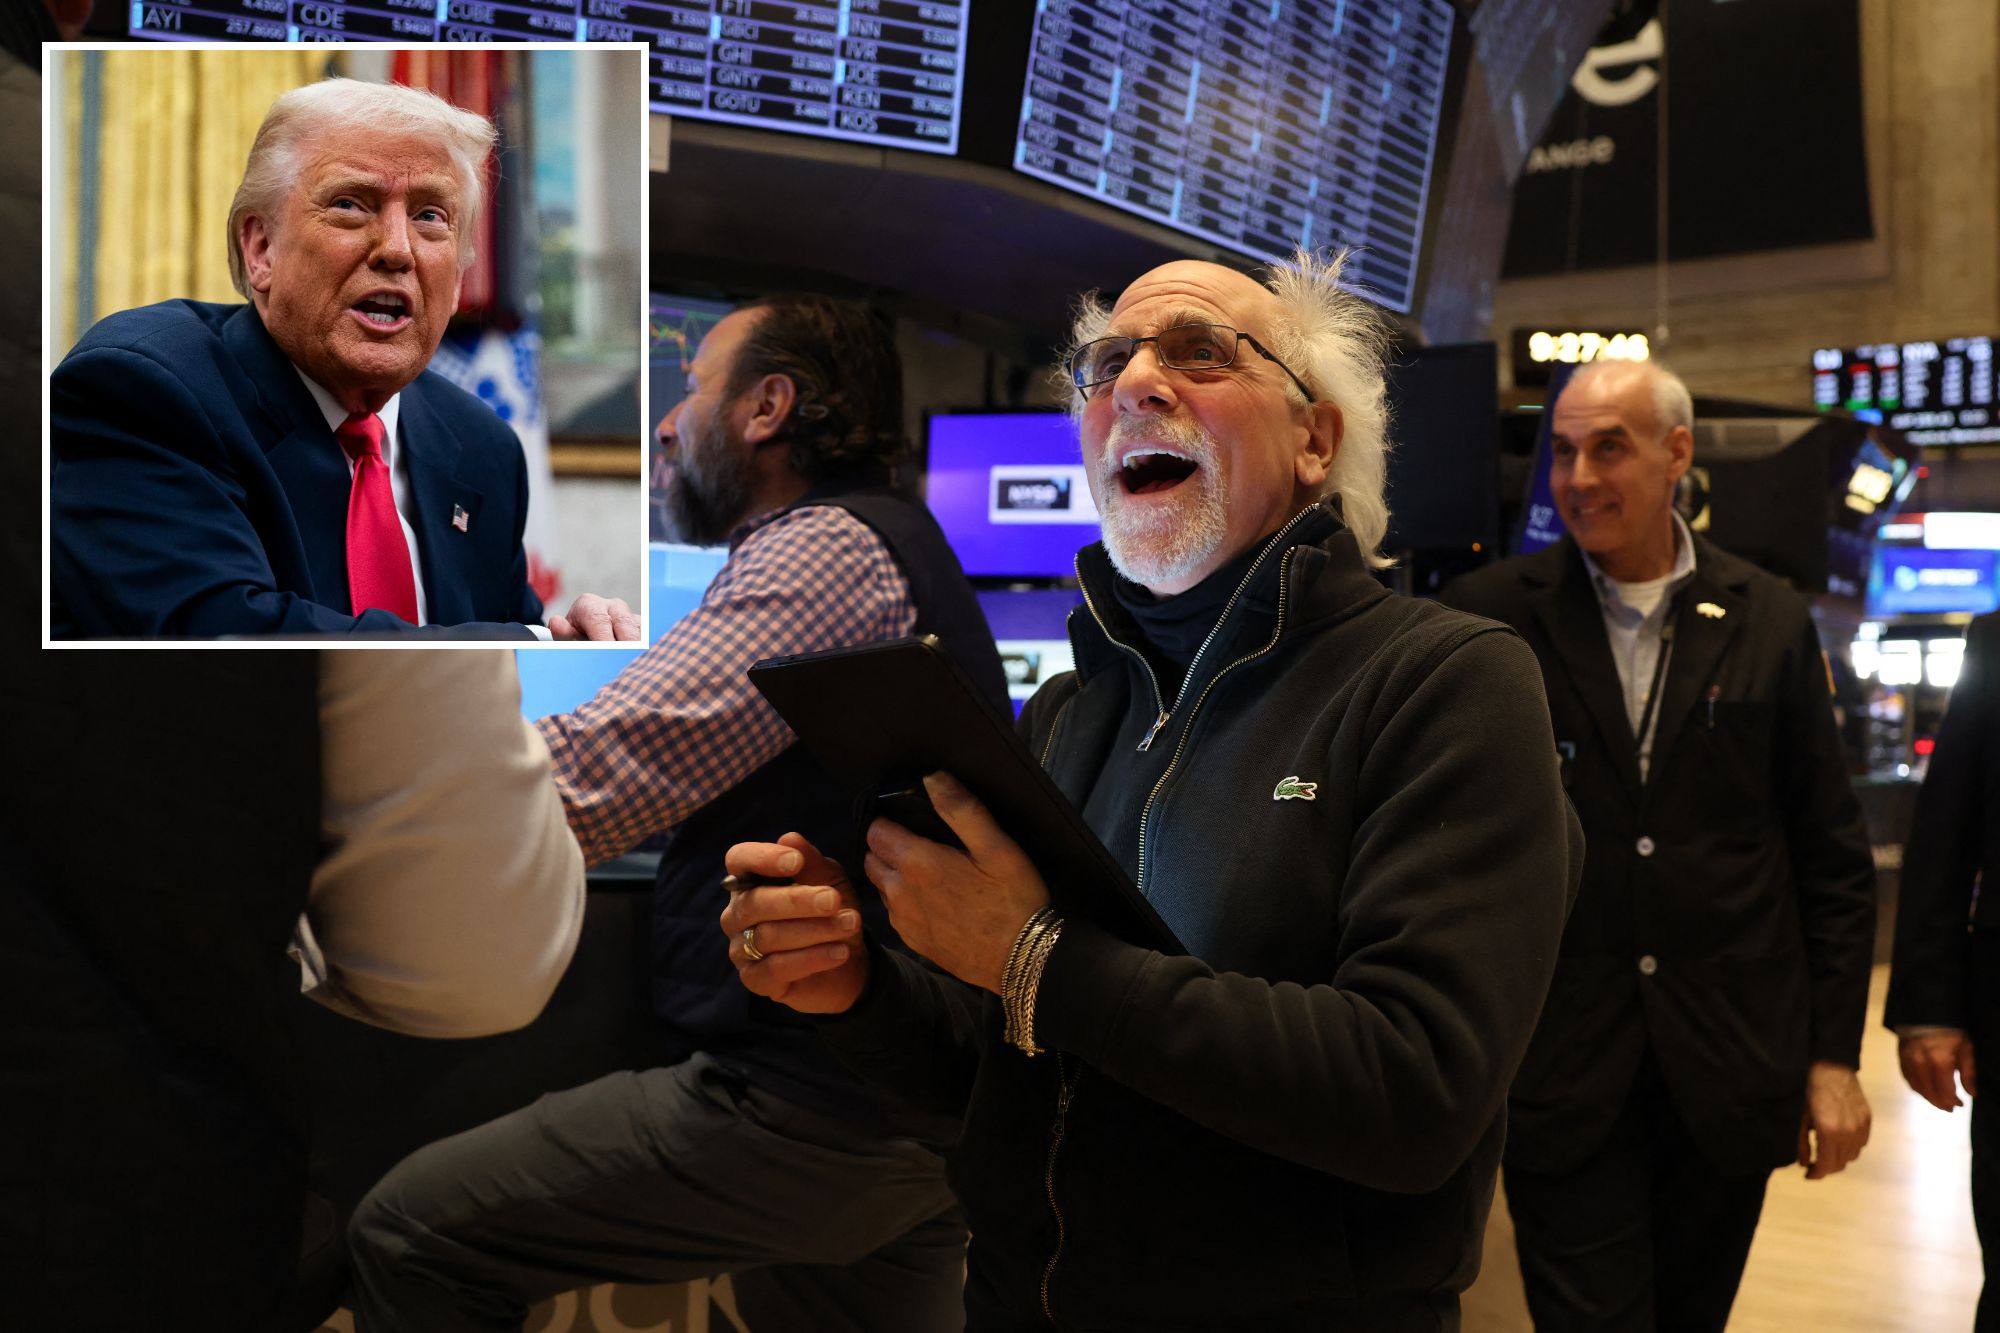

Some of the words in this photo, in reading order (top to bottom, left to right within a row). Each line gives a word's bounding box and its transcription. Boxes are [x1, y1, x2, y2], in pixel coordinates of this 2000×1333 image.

[144, 6, 182, 32] AYI
[301, 4, 346, 30] CDE
[718, 44, 752, 64] GHI
[716, 68, 762, 89] GNTY
[847, 65, 881, 86] JOE
[714, 93, 761, 113] GOTU
[842, 88, 881, 109] KEN
[840, 111, 879, 133] KOS
